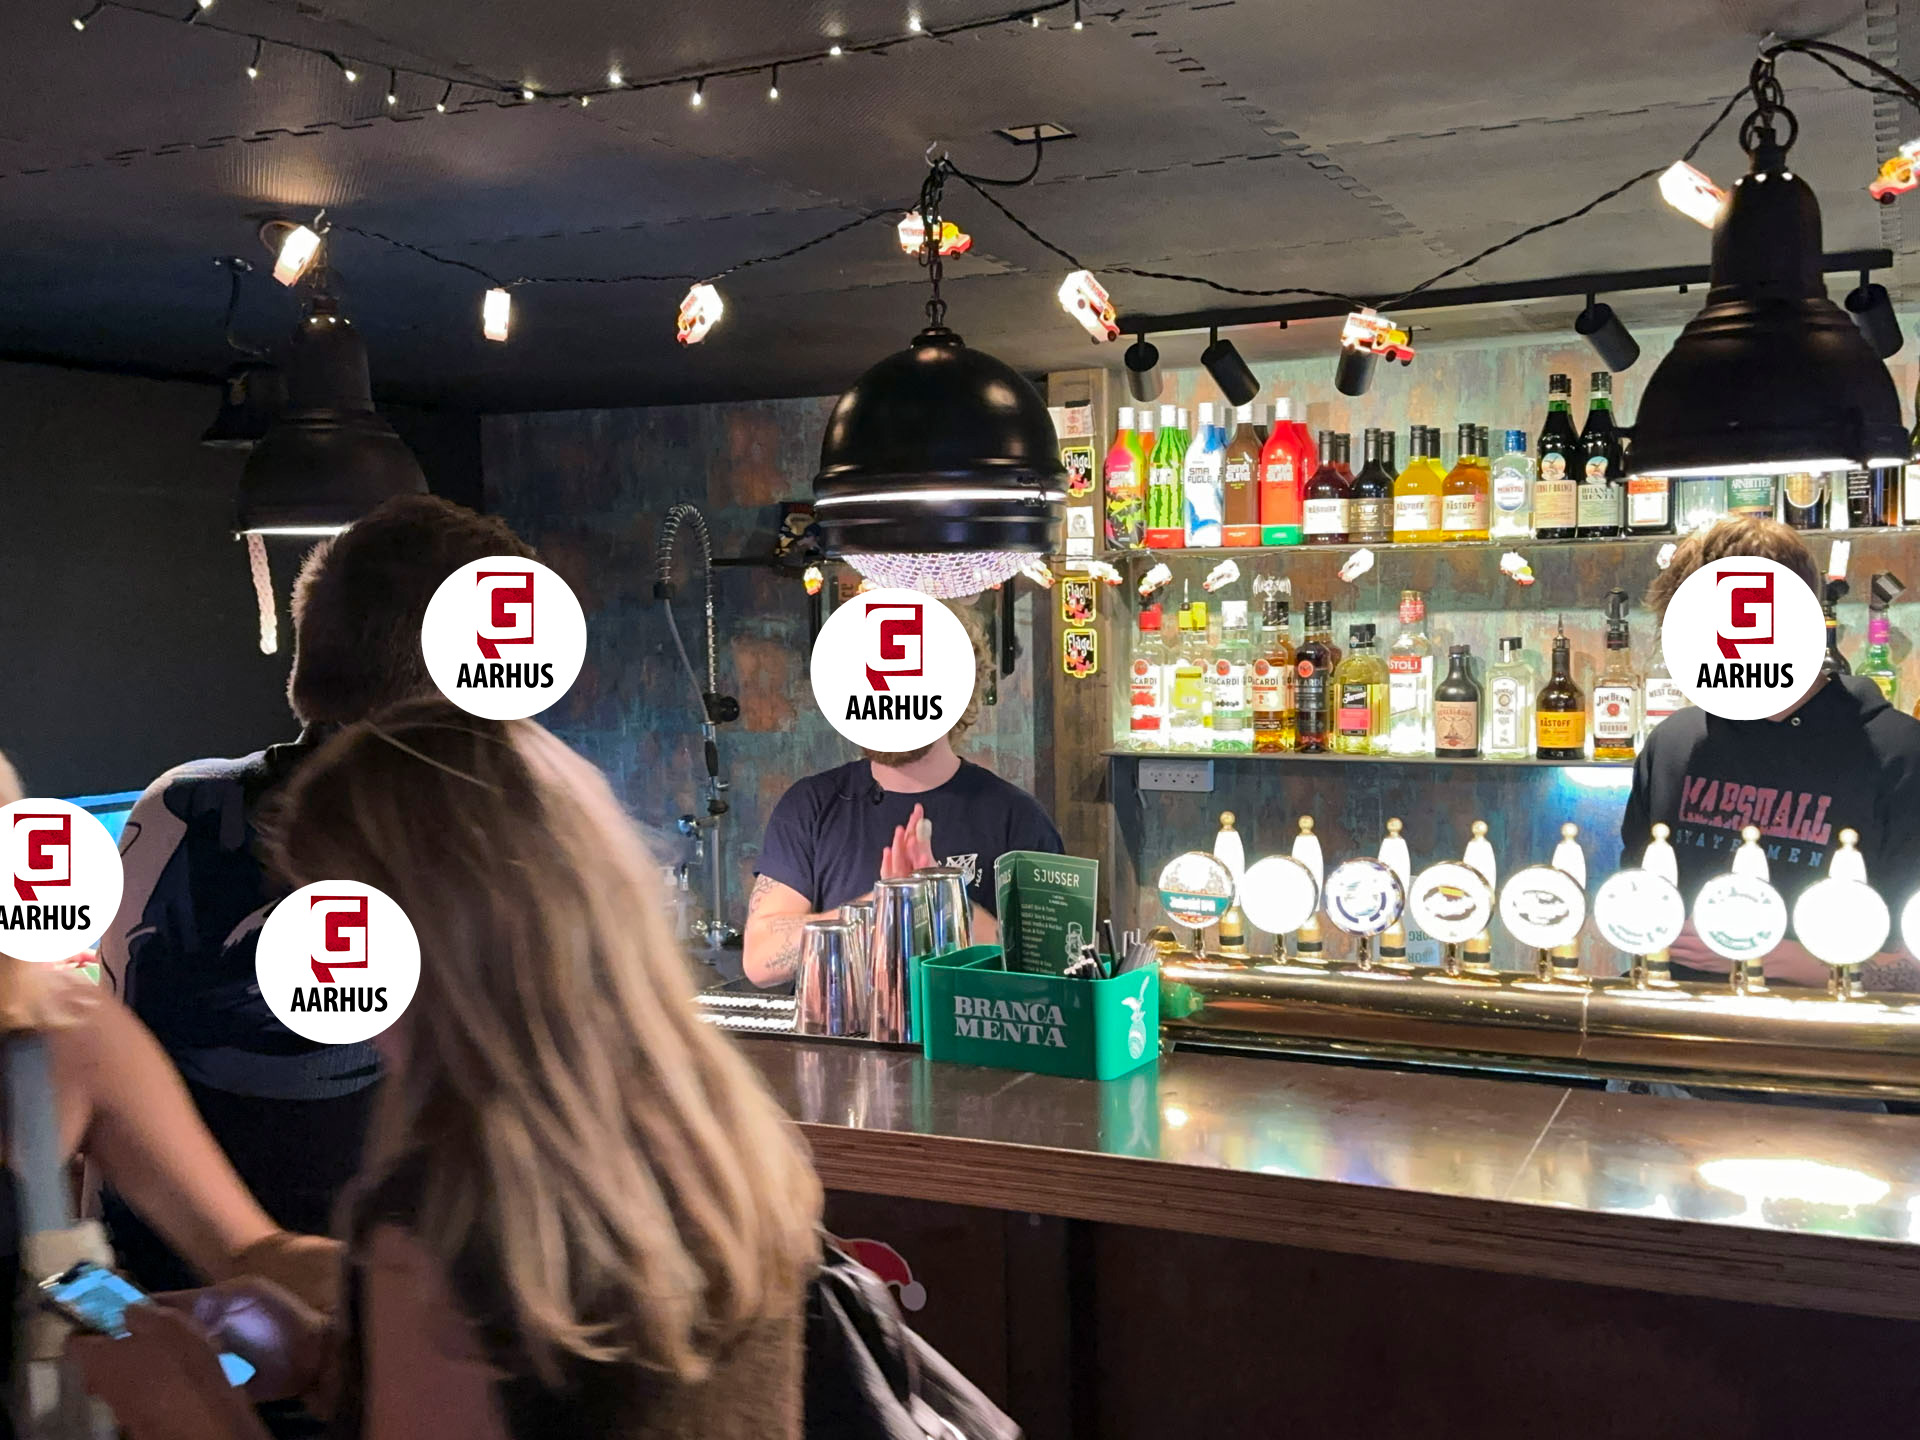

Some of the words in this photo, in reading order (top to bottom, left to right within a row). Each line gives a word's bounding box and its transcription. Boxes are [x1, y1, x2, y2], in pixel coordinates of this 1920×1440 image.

[1679, 775, 1832, 845] MARSHALL
[1033, 867, 1081, 888] SJUSSER
[953, 995, 1068, 1026] BRANCA
[954, 1016, 1068, 1048] MENTA
